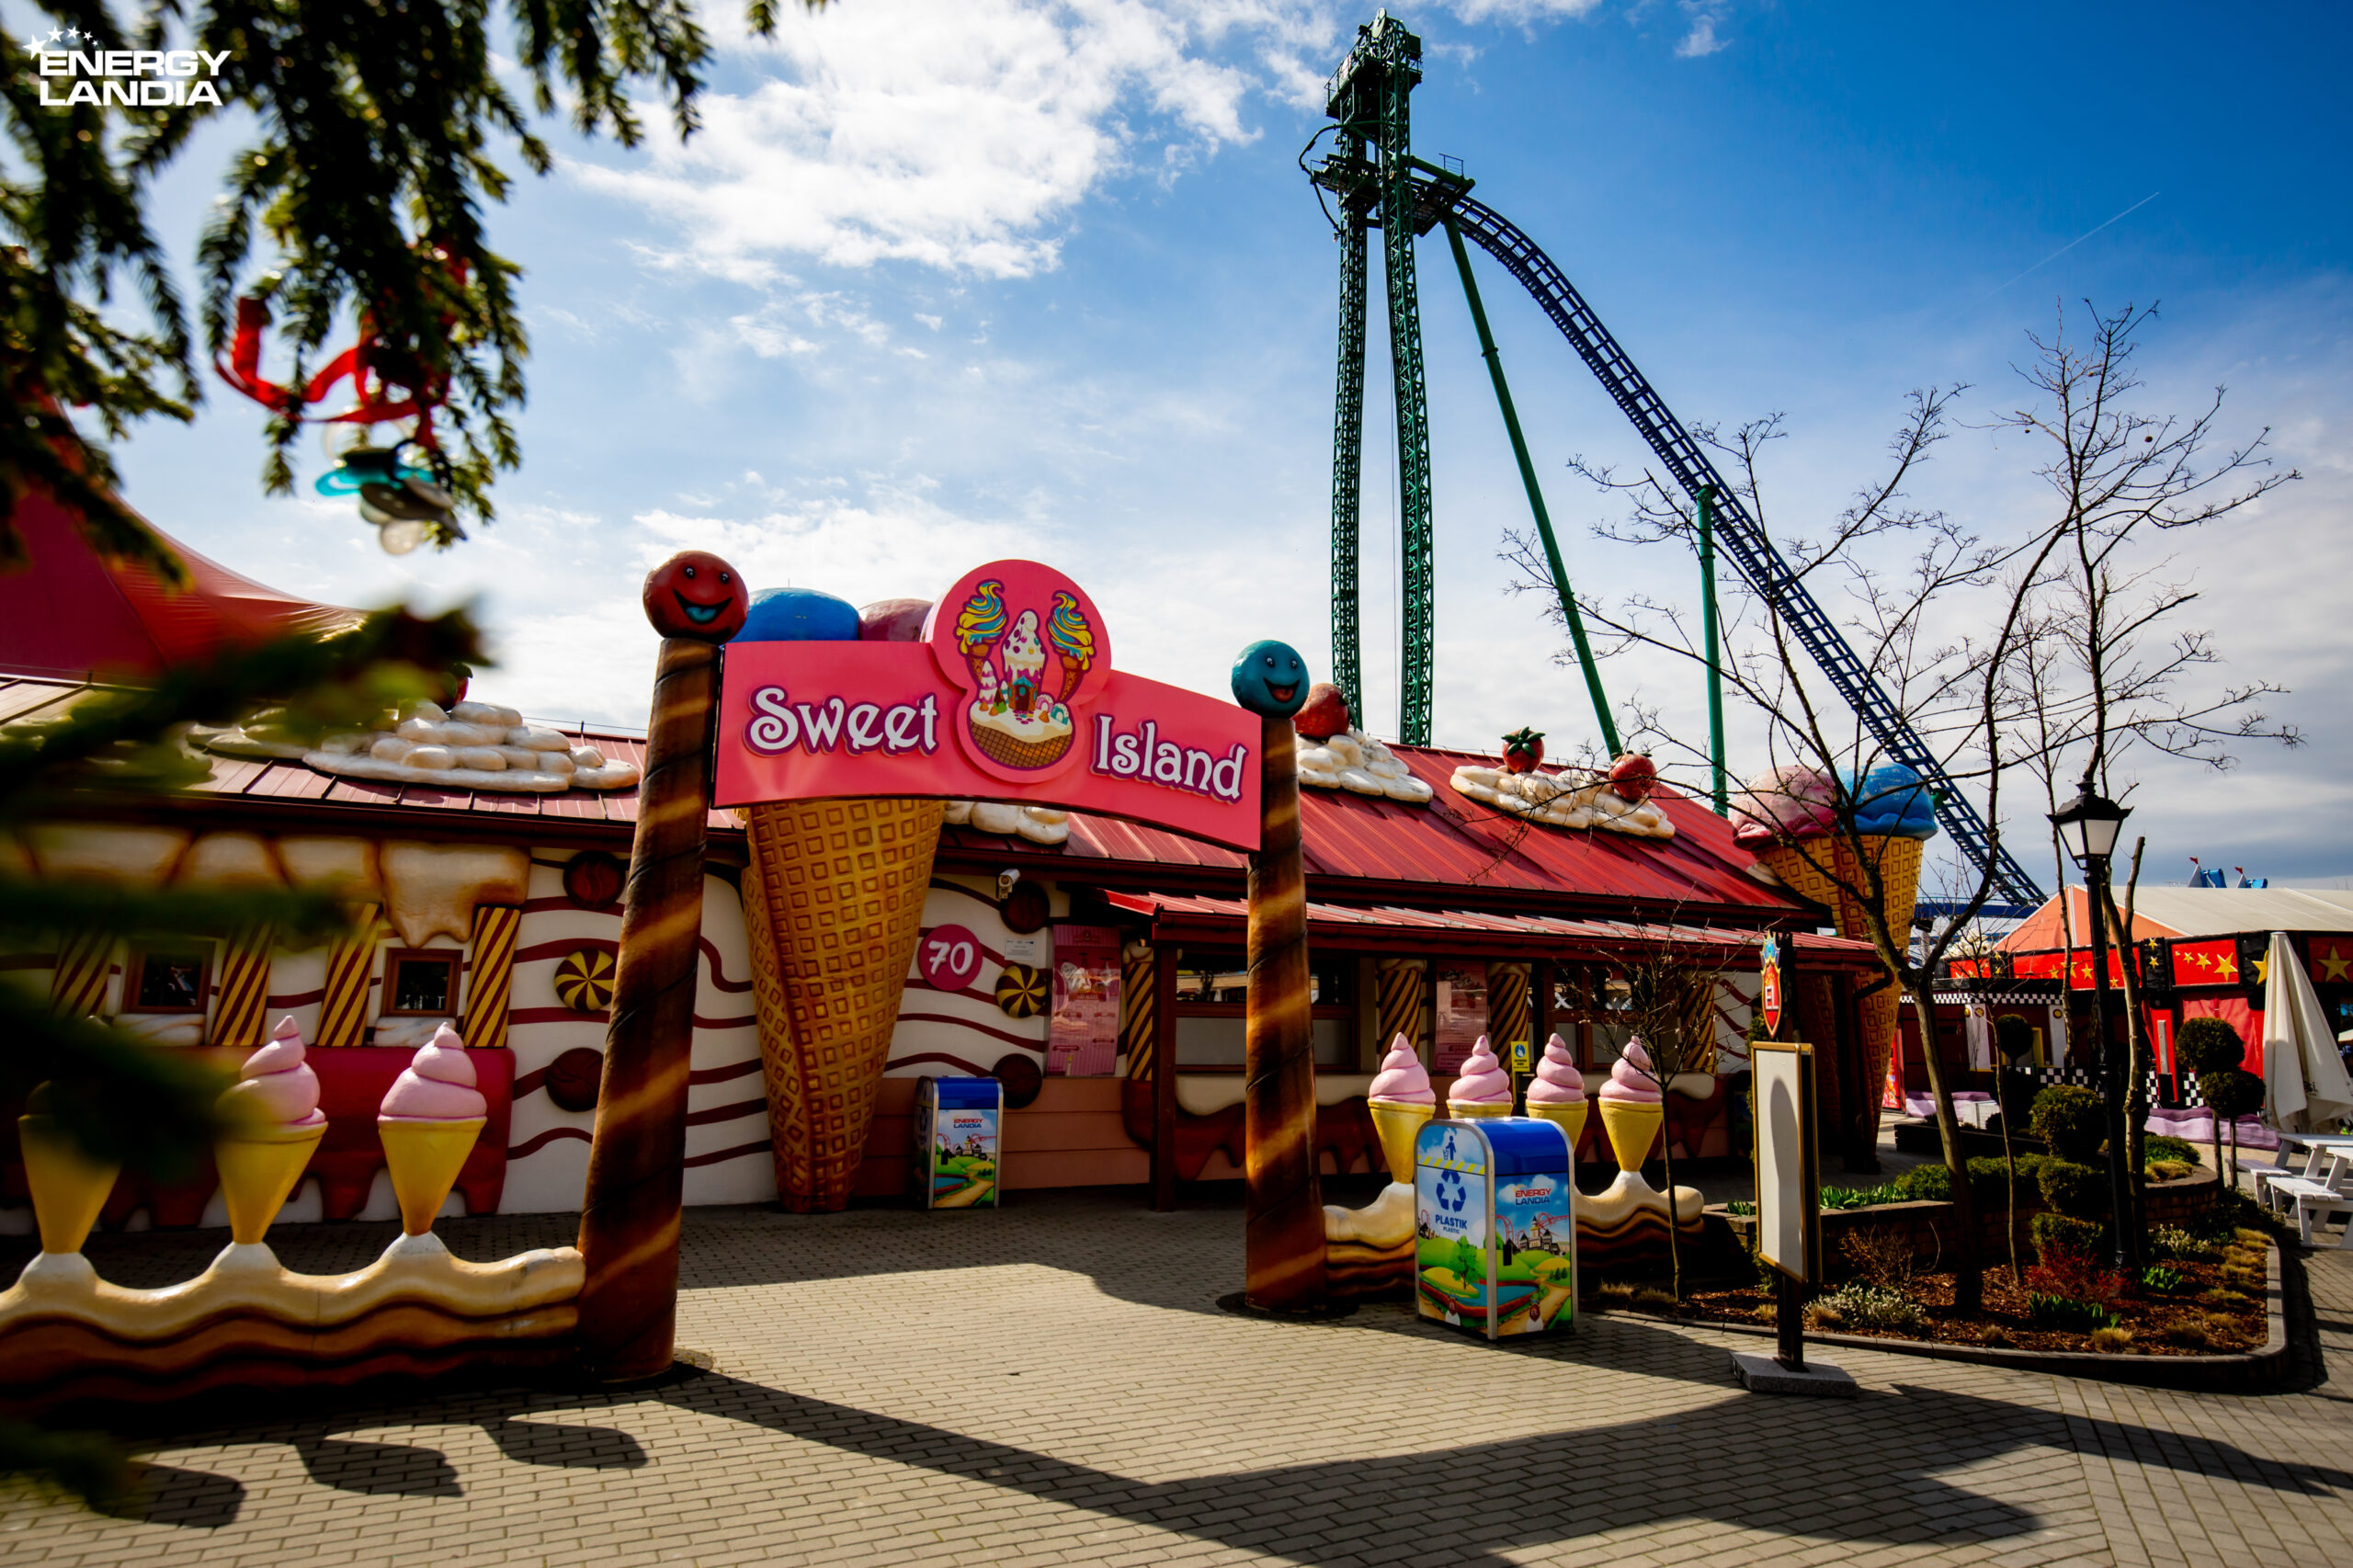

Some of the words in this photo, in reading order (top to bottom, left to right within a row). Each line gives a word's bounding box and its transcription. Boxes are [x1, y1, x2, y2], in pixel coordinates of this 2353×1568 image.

[747, 687, 938, 754] Sweet
[1097, 713, 1246, 801] Island
[928, 939, 974, 977] 70
[1765, 984, 1779, 1010] EL
[1515, 1187, 1552, 1198] ENERGY
[1515, 1196, 1551, 1205] LANDIA
[1435, 1214, 1468, 1230] PLASTIK
[1443, 1226, 1460, 1234] PLASTIC
